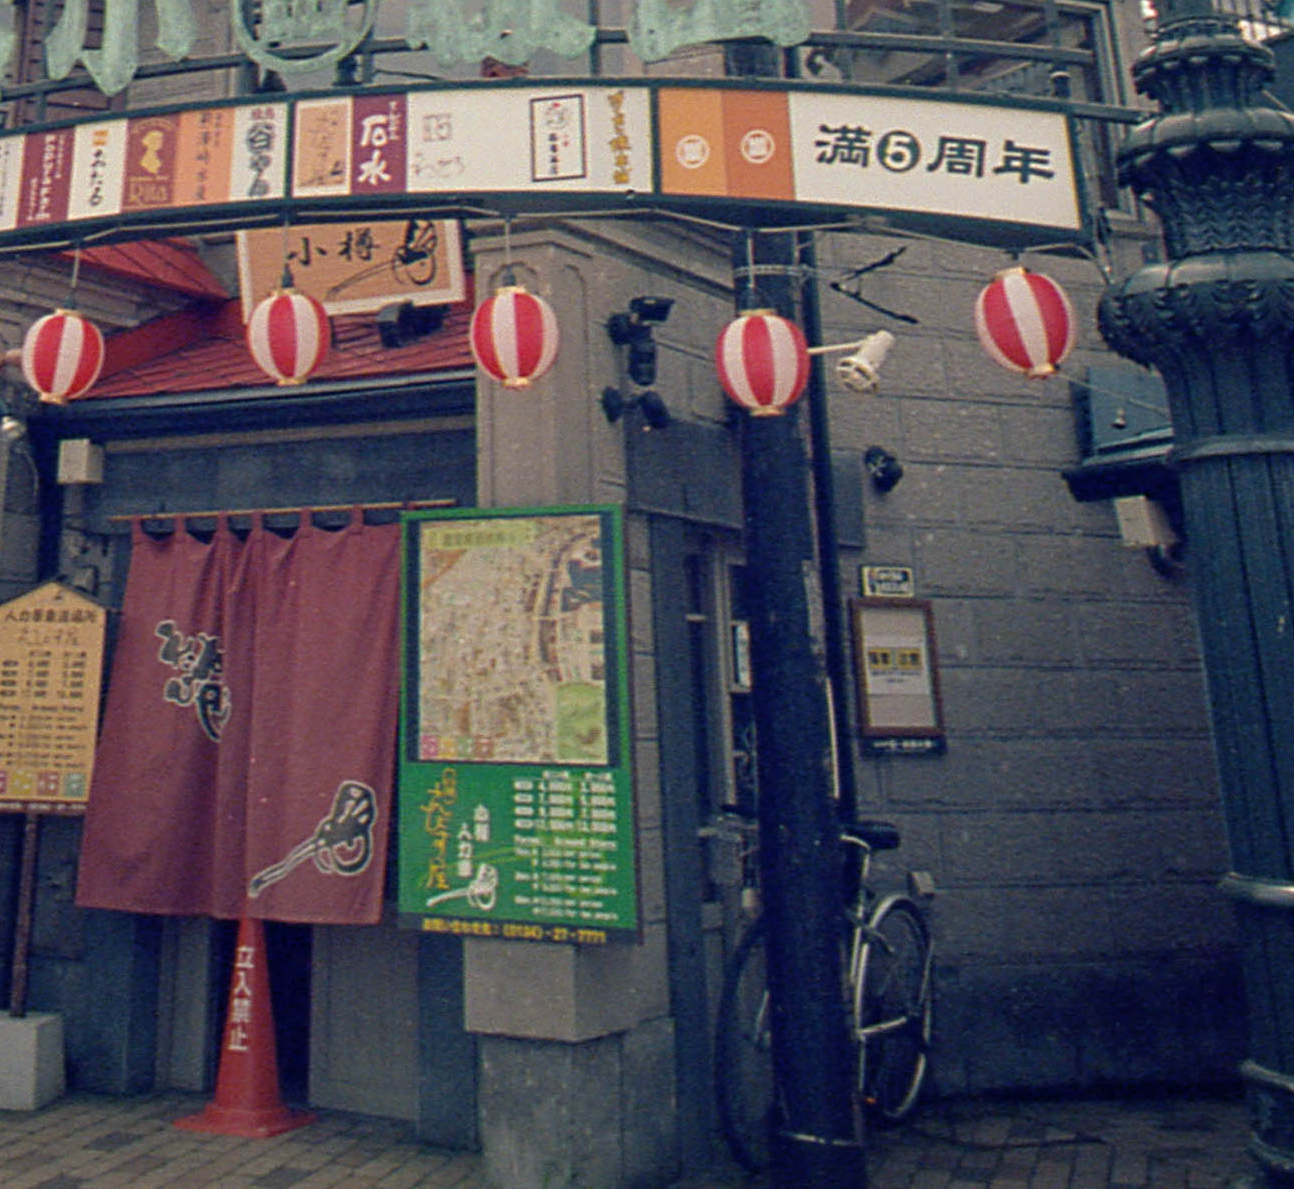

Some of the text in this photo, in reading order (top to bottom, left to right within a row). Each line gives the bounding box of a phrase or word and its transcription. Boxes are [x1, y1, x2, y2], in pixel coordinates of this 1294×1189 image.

[286, 228, 381, 267] 小樽
[228, 945, 256, 1052] 立入禁止
